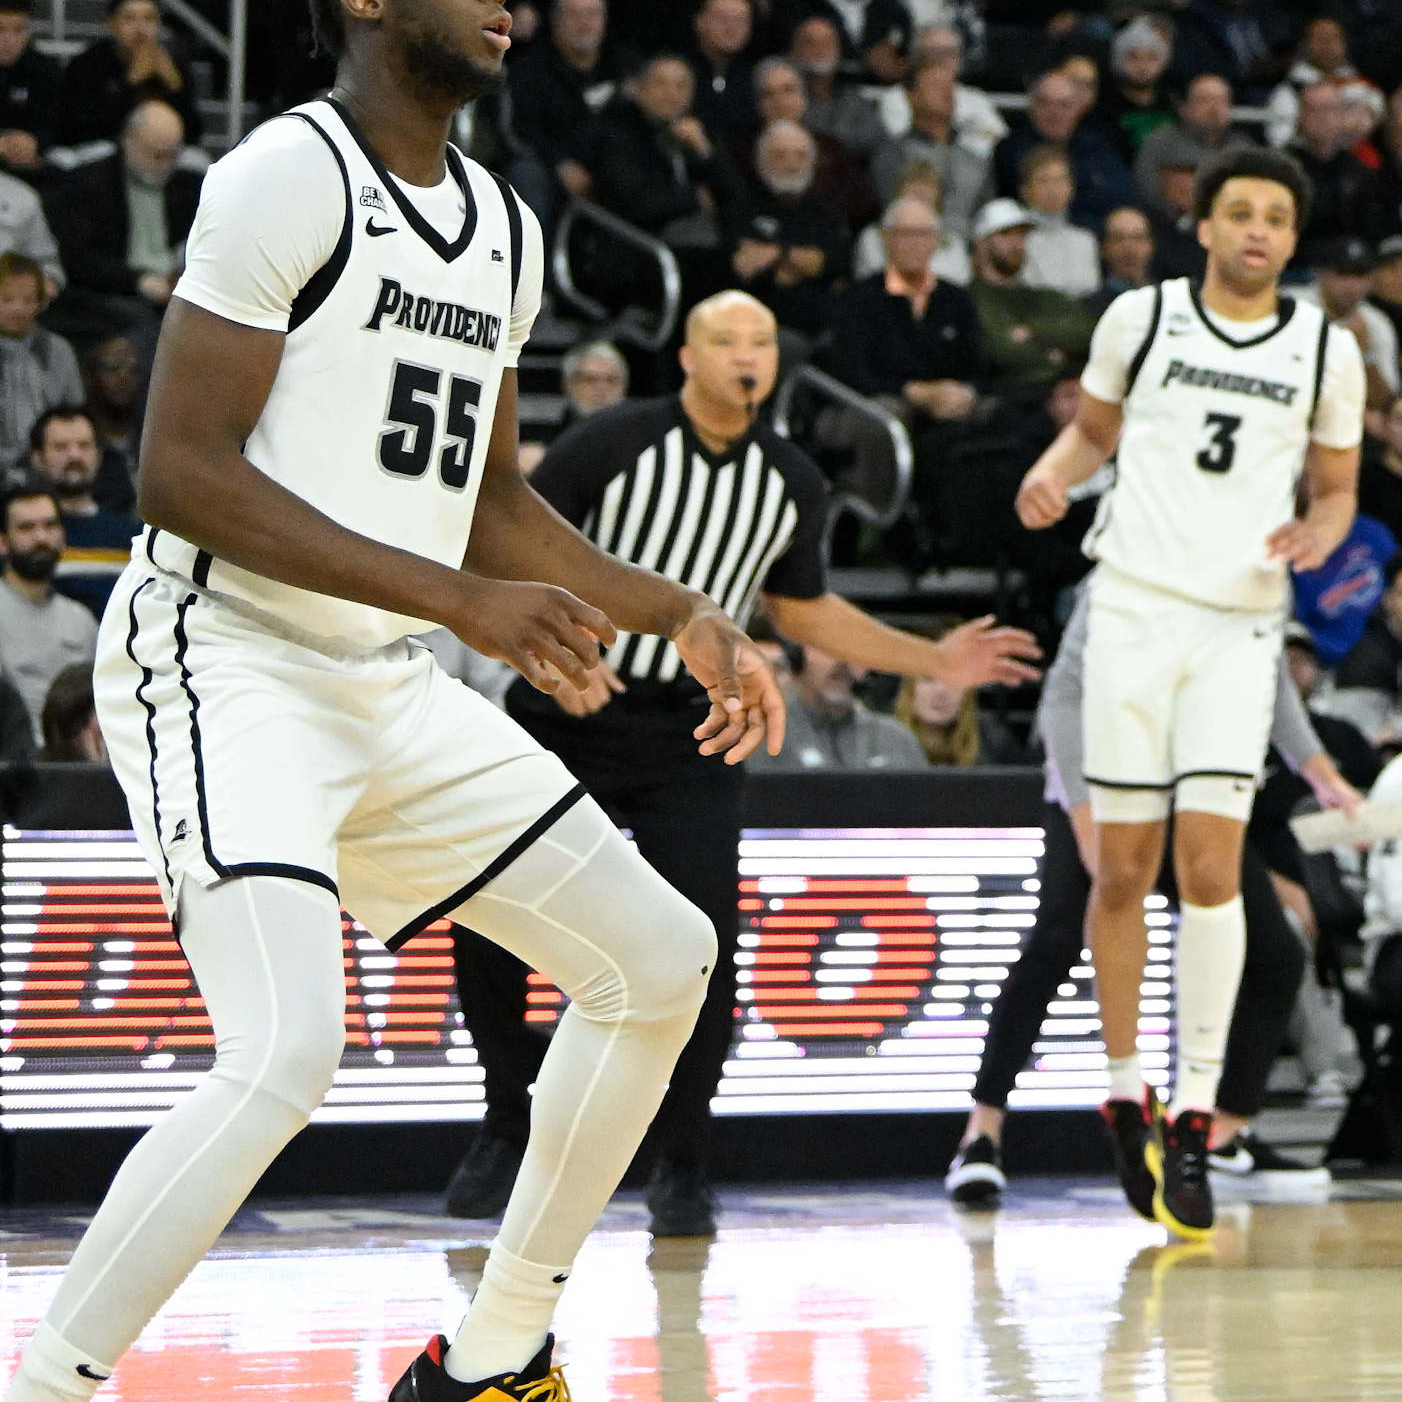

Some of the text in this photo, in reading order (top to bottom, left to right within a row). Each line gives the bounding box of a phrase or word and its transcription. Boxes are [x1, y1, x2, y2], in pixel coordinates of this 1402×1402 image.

[360, 275, 501, 355] PROVIDENC
[375, 358, 484, 494] 55
[1196, 411, 1244, 475] 3
